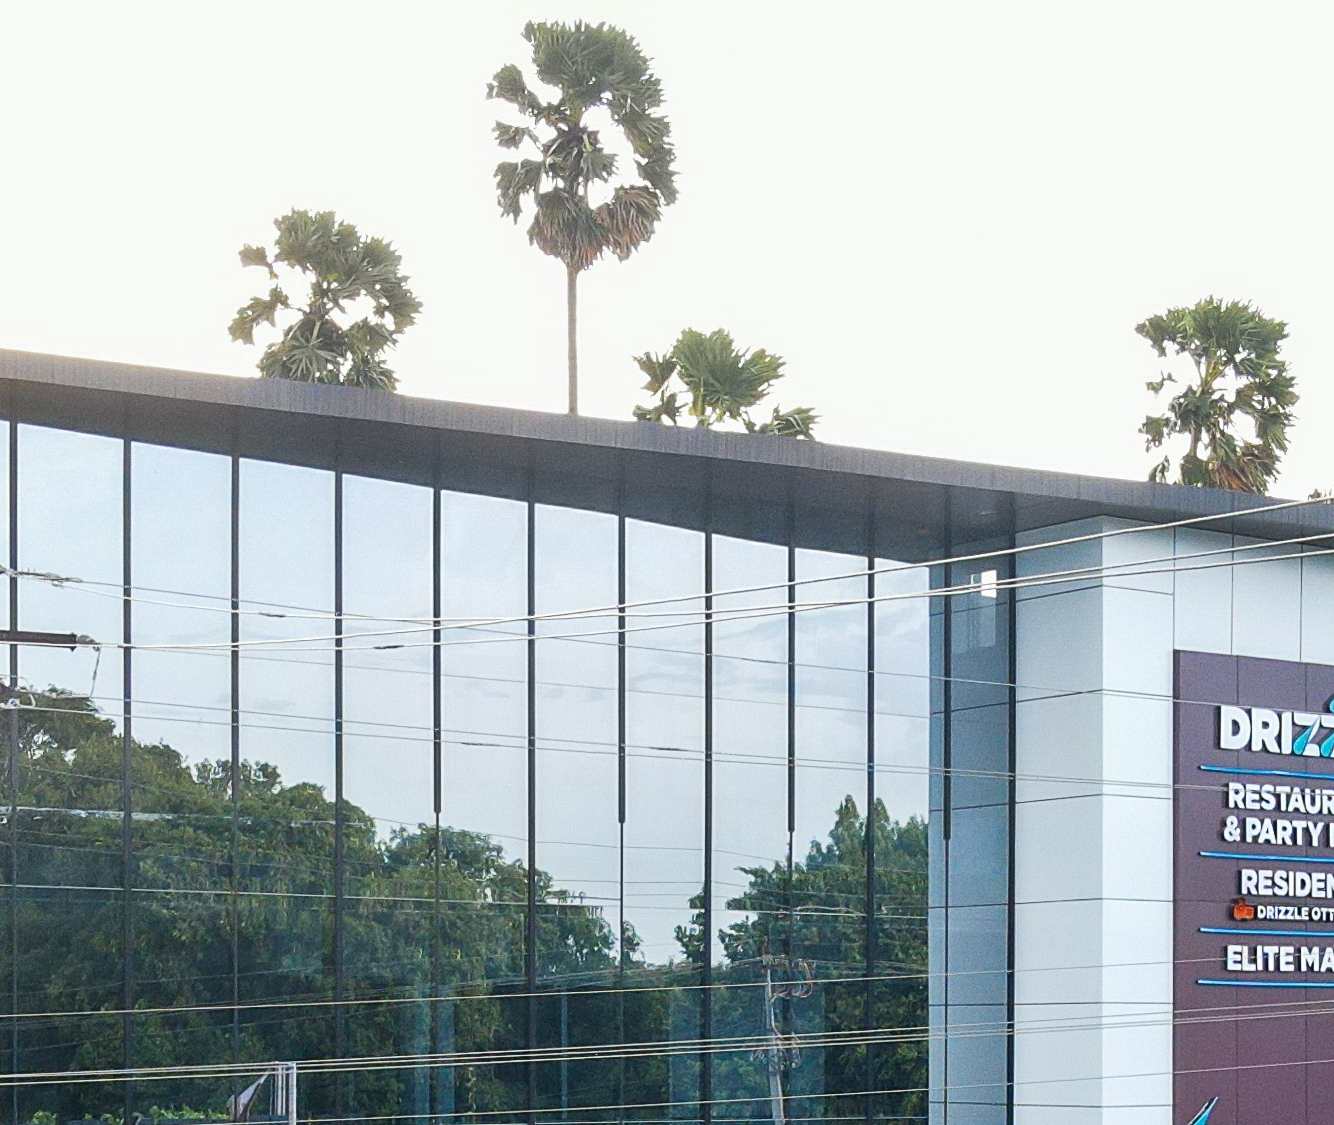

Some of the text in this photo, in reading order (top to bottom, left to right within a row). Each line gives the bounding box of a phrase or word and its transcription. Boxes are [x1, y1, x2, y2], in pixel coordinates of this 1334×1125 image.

[1223, 817, 1241, 841] &
[1245, 818, 1323, 847] PARTY
[1257, 905, 1309, 921] DRIZZLE
[1226, 944, 1295, 972] ELITE
